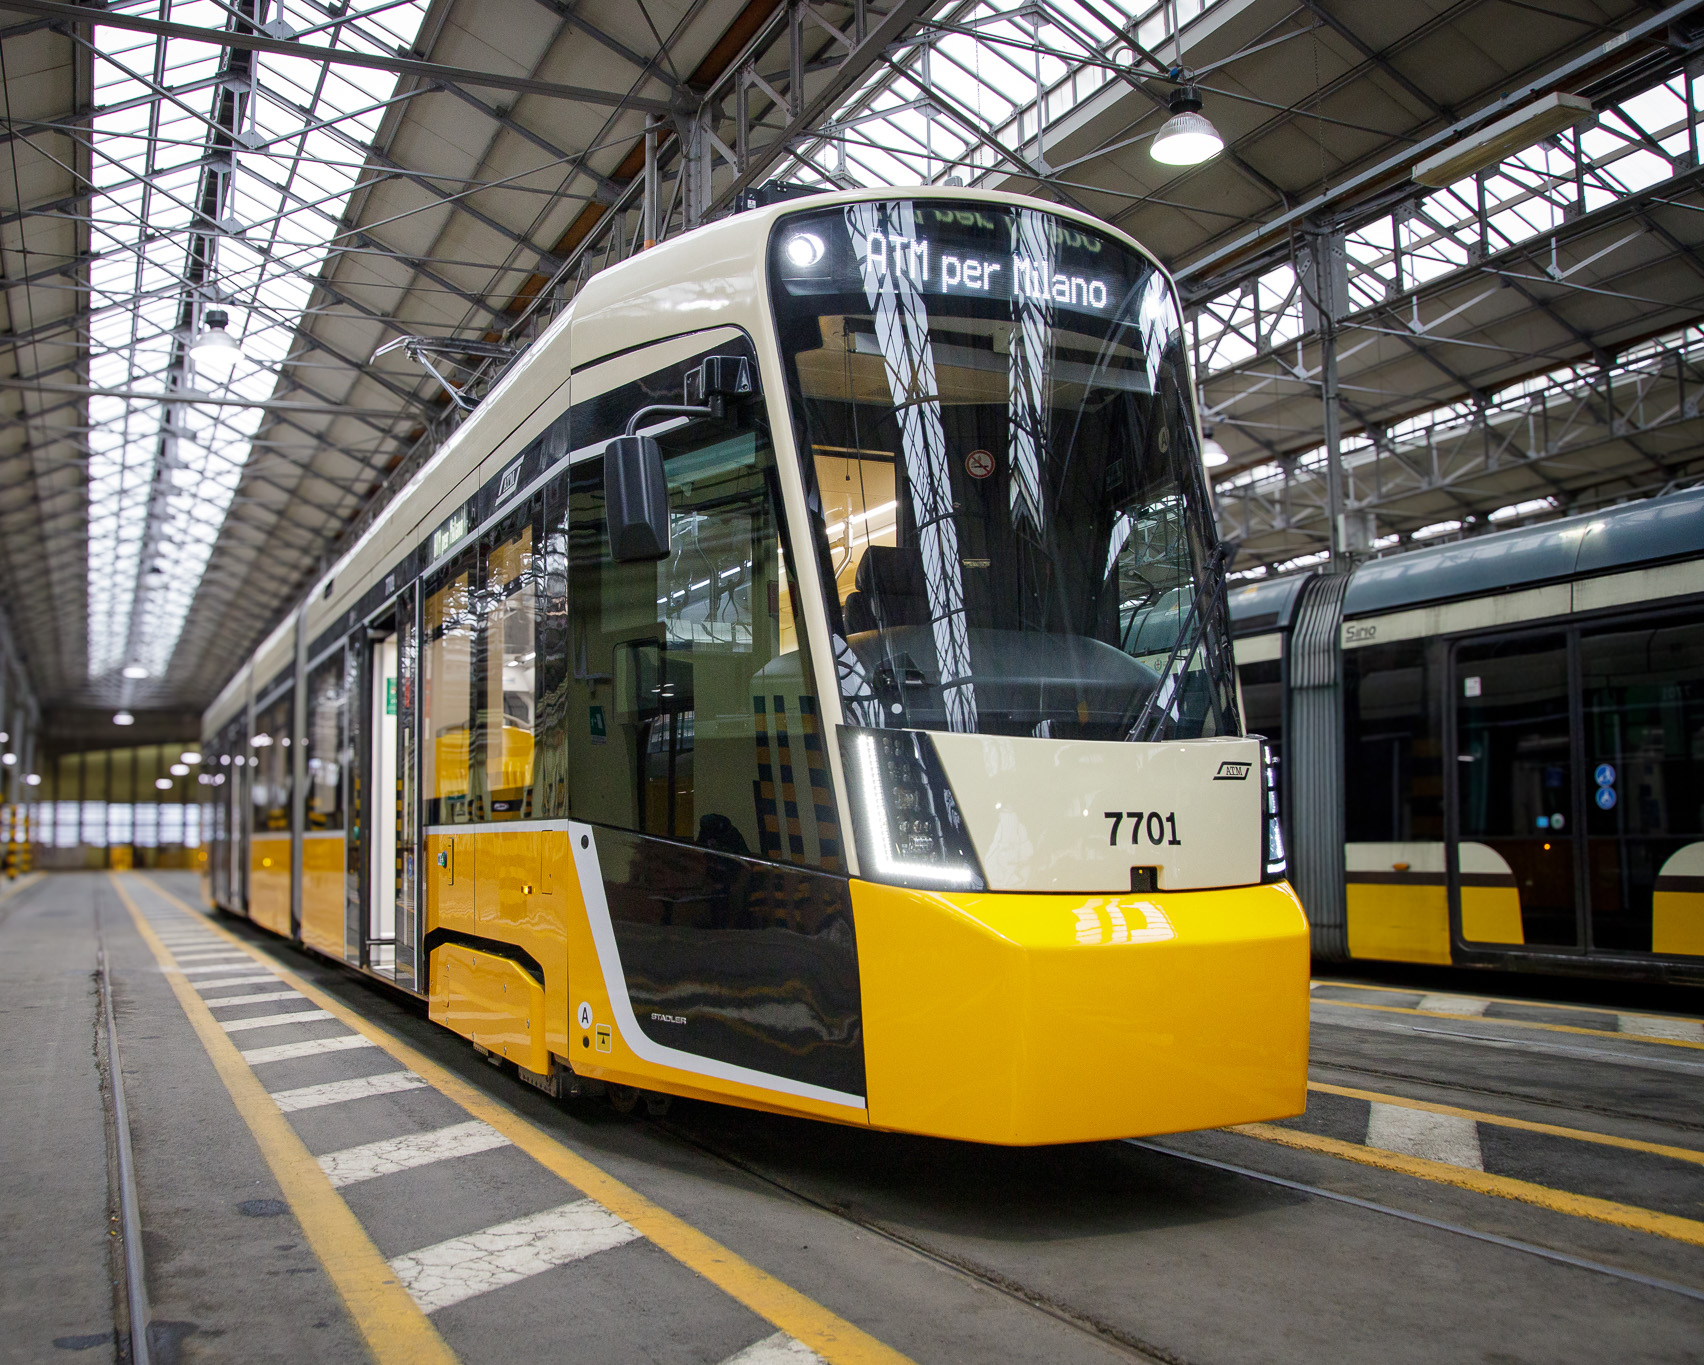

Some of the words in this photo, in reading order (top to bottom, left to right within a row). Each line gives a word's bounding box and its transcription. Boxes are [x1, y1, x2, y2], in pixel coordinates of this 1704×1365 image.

[866, 230, 928, 281] ATM
[941, 255, 1001, 293] per
[1013, 254, 1107, 309] Milano
[1104, 811, 1181, 846] 7701
[581, 1006, 589, 1024] A
[651, 1012, 687, 1025] STADLER
